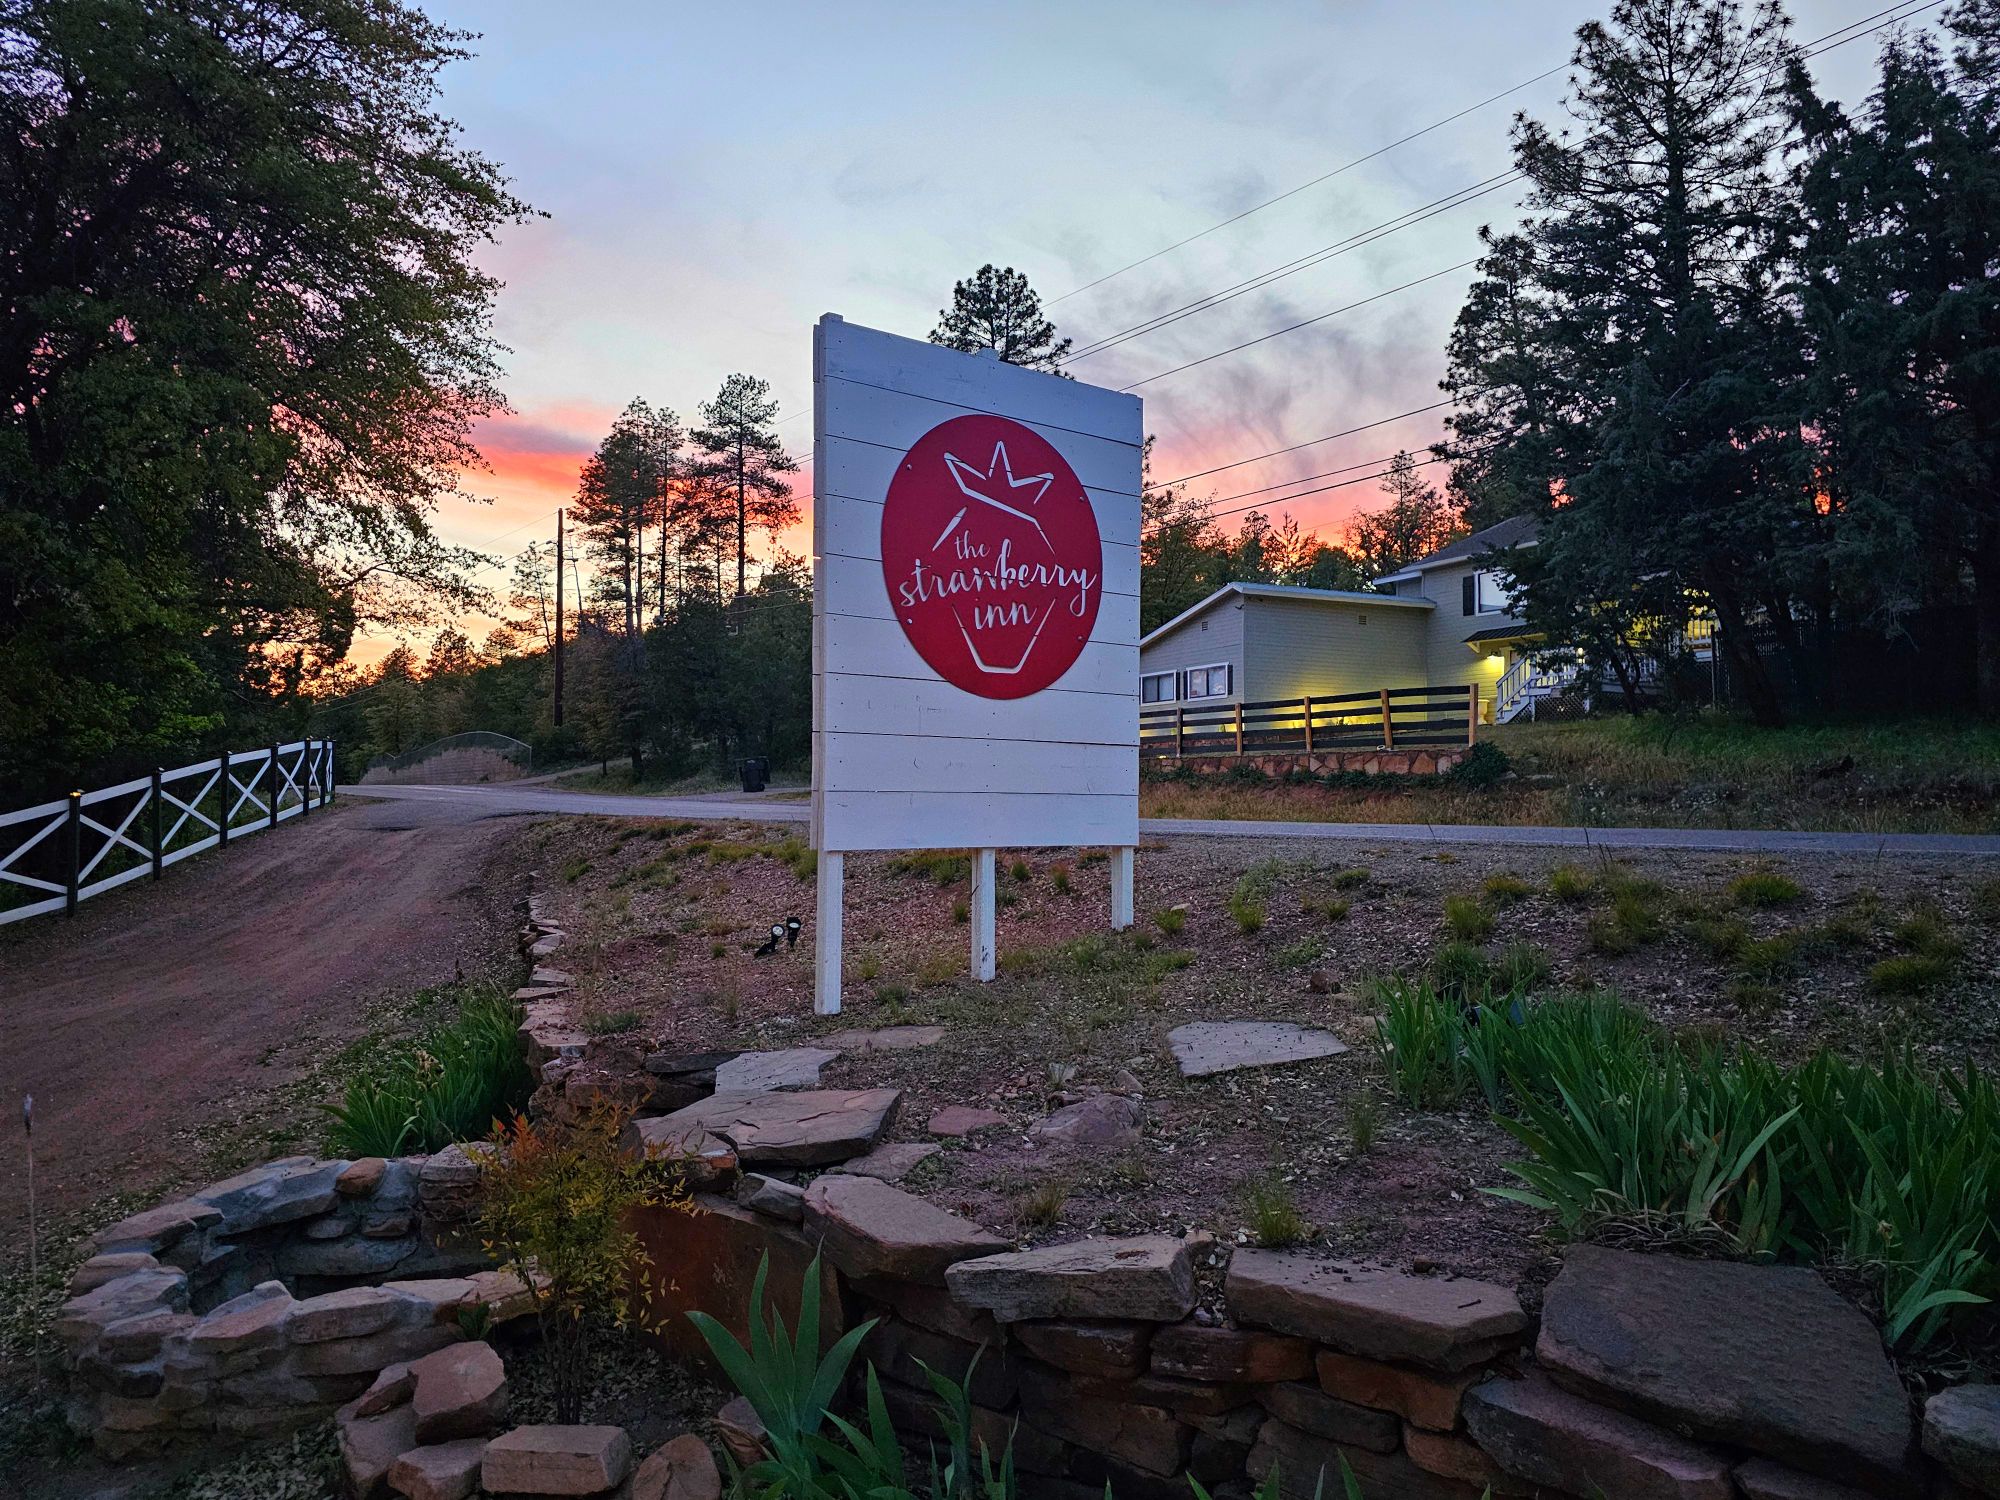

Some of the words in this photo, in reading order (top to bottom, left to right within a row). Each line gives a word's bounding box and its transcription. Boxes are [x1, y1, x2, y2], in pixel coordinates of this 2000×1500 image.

[954, 530, 990, 560] the
[899, 538, 1097, 617] strawberry
[973, 598, 1037, 630] inn
